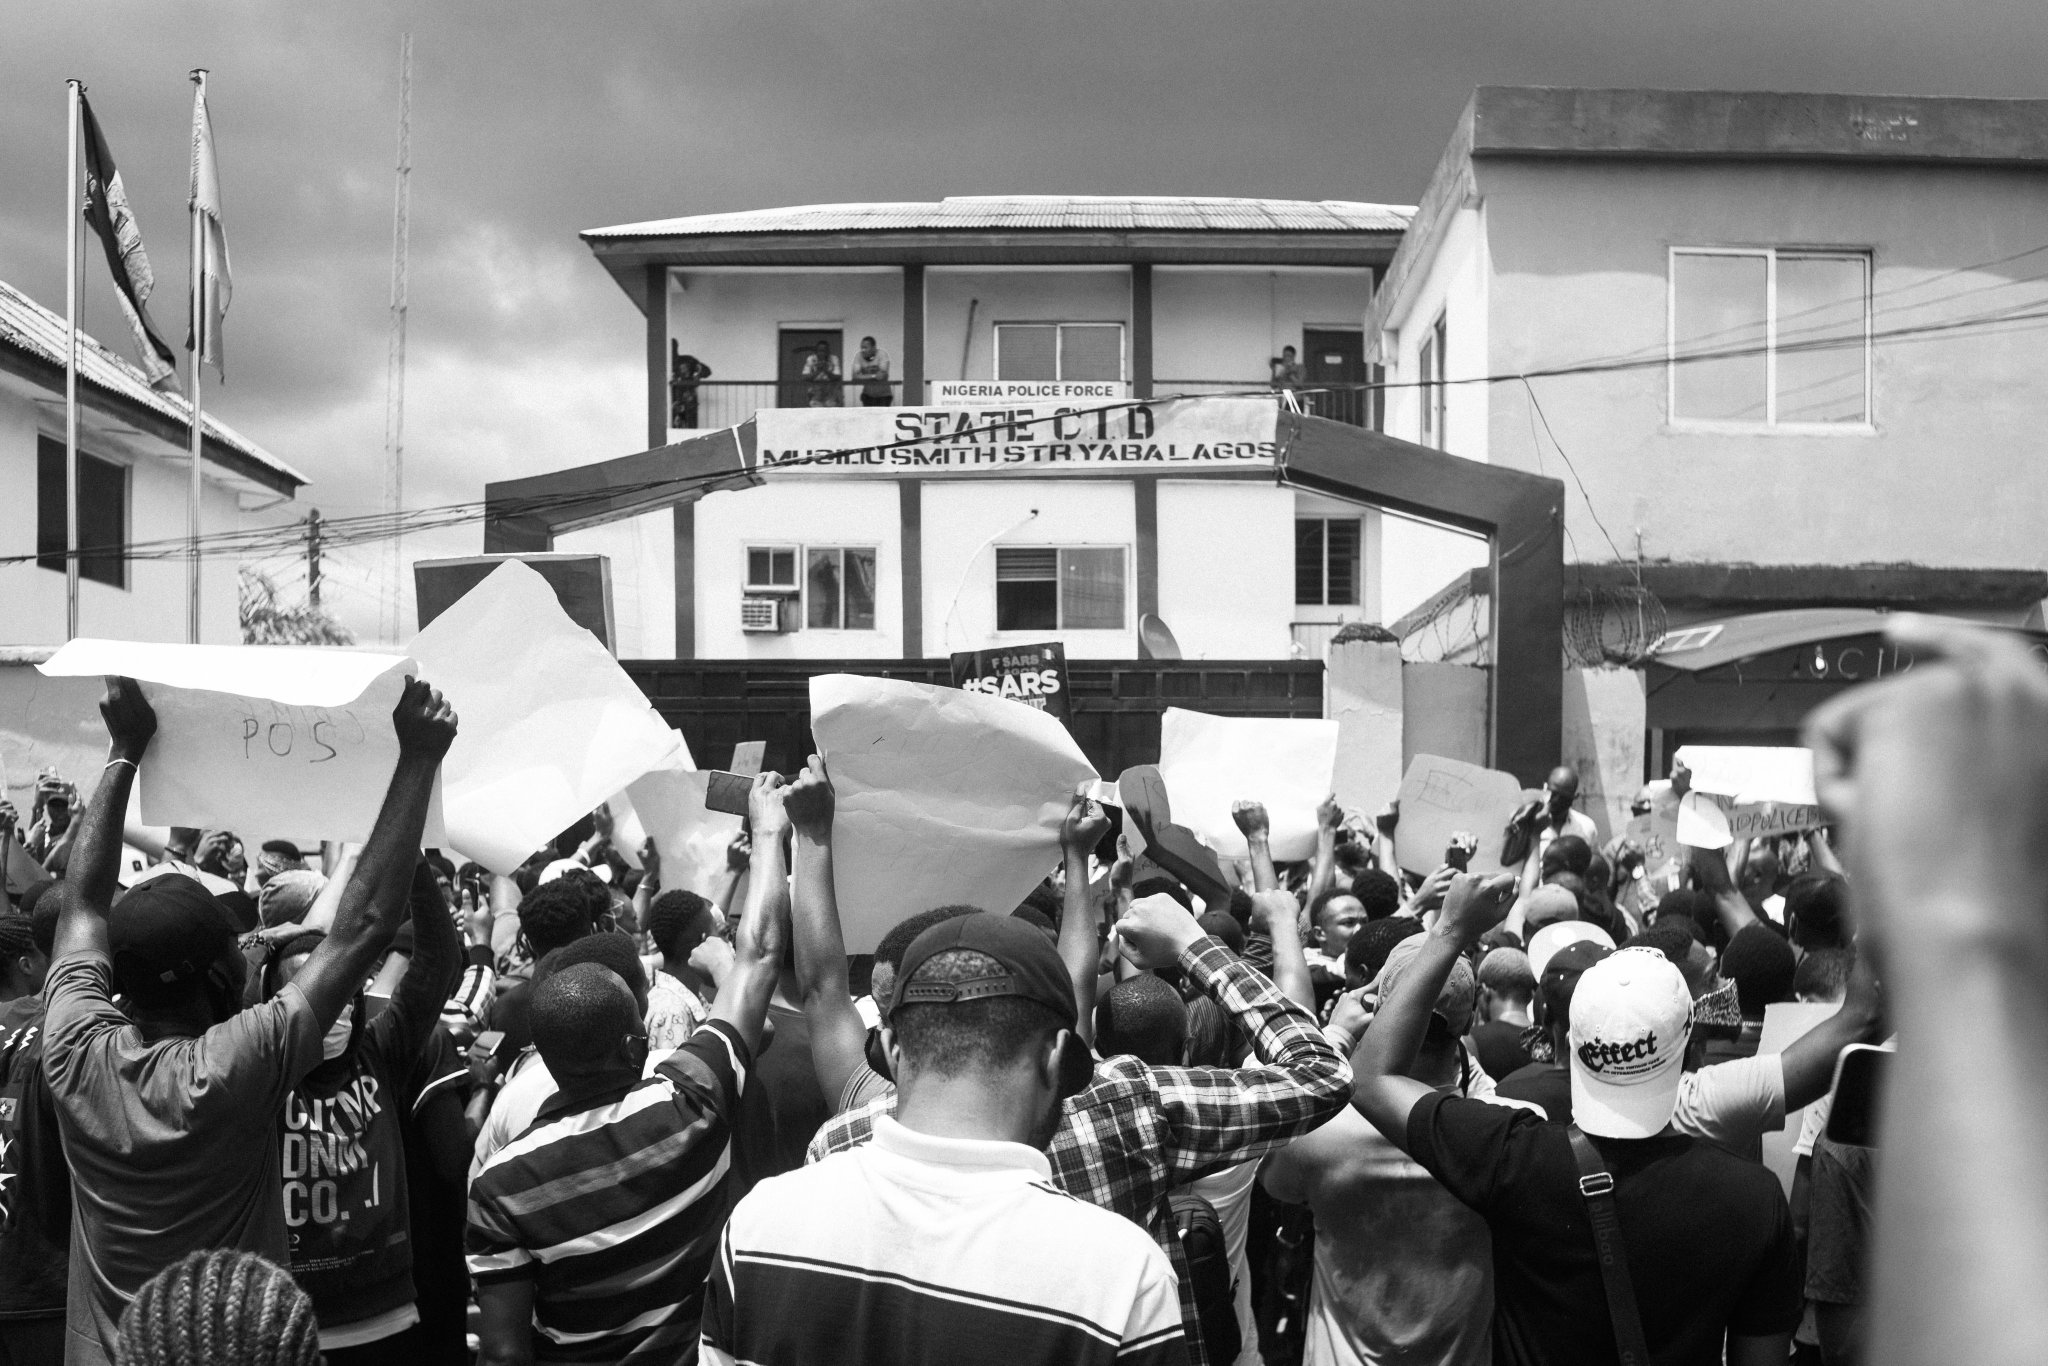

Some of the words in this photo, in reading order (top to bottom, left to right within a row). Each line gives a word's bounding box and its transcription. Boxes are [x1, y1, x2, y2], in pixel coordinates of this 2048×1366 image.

[942, 385, 1003, 397] NIGERIA
[1007, 385, 1060, 397] POLICE
[1064, 385, 1114, 397] FORCE
[895, 408, 1034, 443] STATE
[890, 447, 997, 466] SMITH
[1168, 441, 1276, 461] LAGOS
[1002, 654, 1040, 668] SARS
[963, 669, 1060, 697] #SARS
[243, 718, 337, 764] POS
